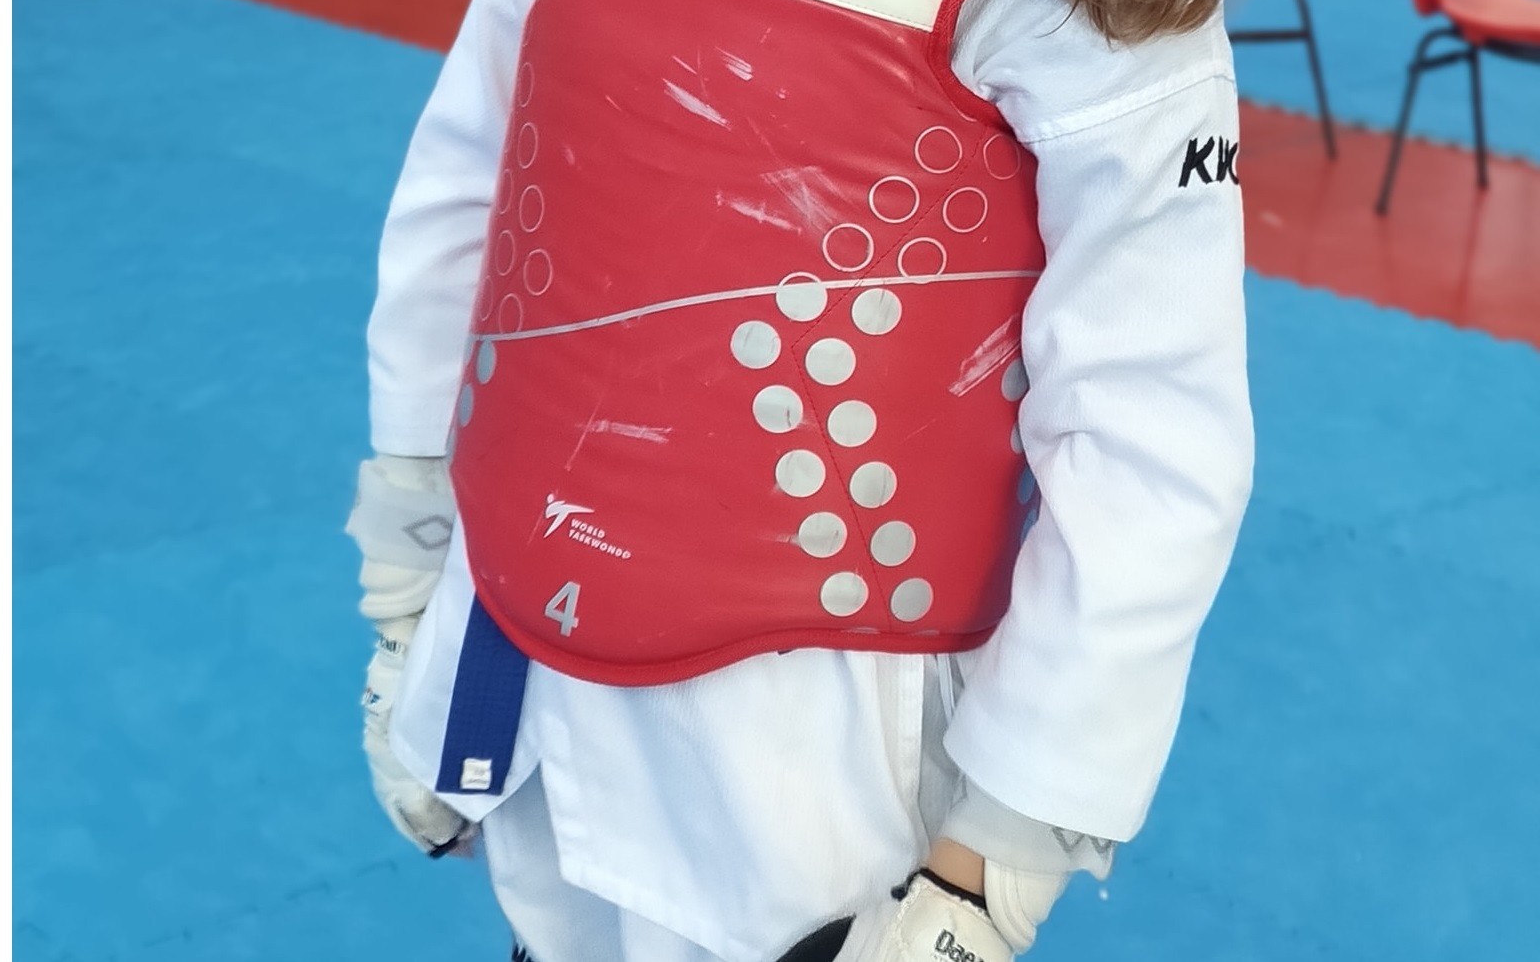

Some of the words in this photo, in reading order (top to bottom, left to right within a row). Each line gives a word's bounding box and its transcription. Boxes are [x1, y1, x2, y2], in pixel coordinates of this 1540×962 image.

[571, 518, 605, 539] WORLD
[568, 529, 632, 559] TAEKWONDO
[544, 581, 581, 637] 4
